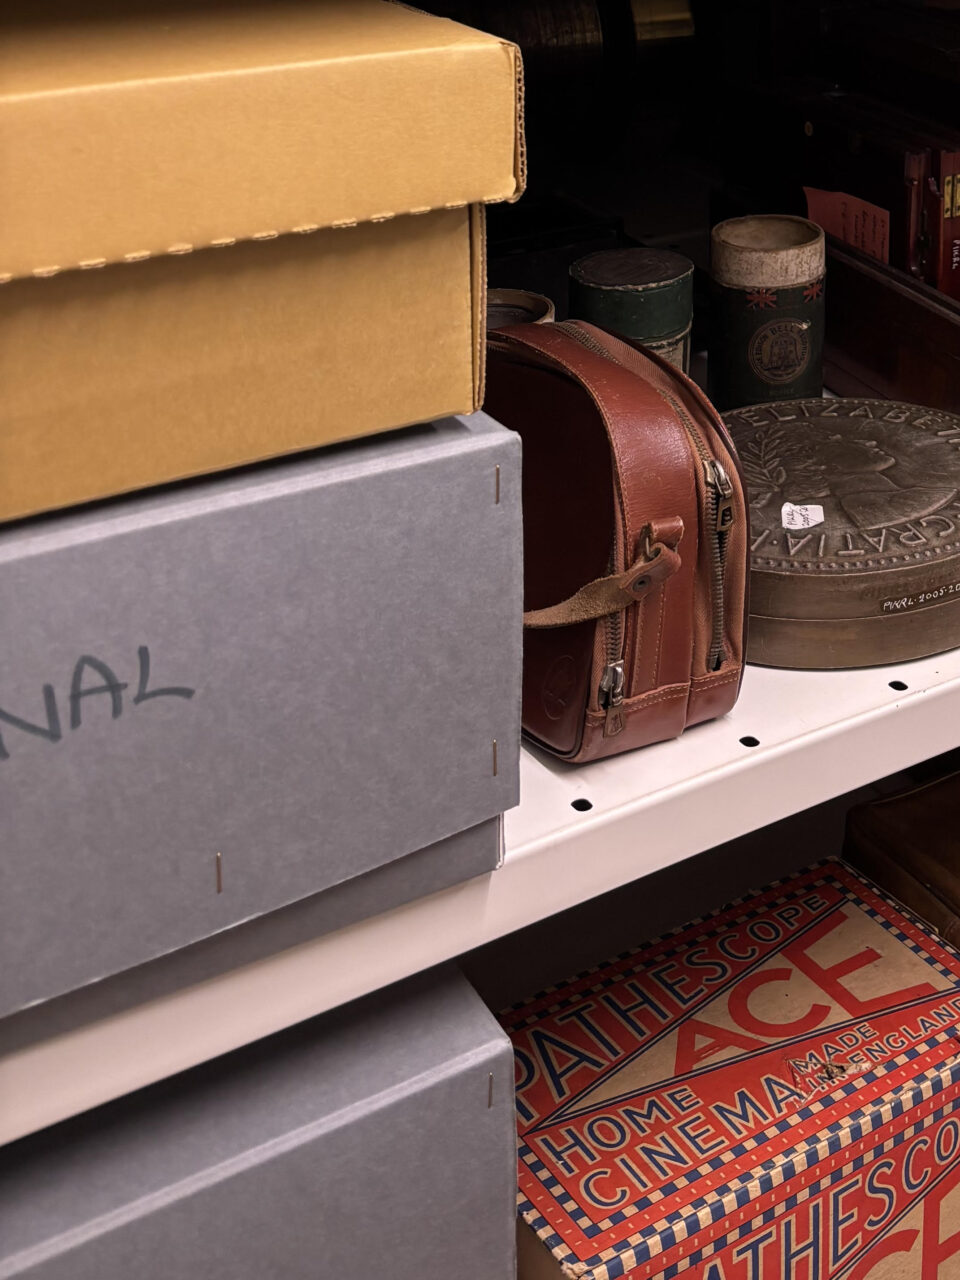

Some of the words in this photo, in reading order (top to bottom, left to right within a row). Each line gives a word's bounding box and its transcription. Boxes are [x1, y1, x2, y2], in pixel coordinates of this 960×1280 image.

[515, 893, 830, 1122] PATHESCOPE
[674, 909, 942, 1078] ACE
[791, 1022, 879, 1076] MADE
[538, 1084, 706, 1177] HOME
[581, 1073, 803, 1210] CINEMA
